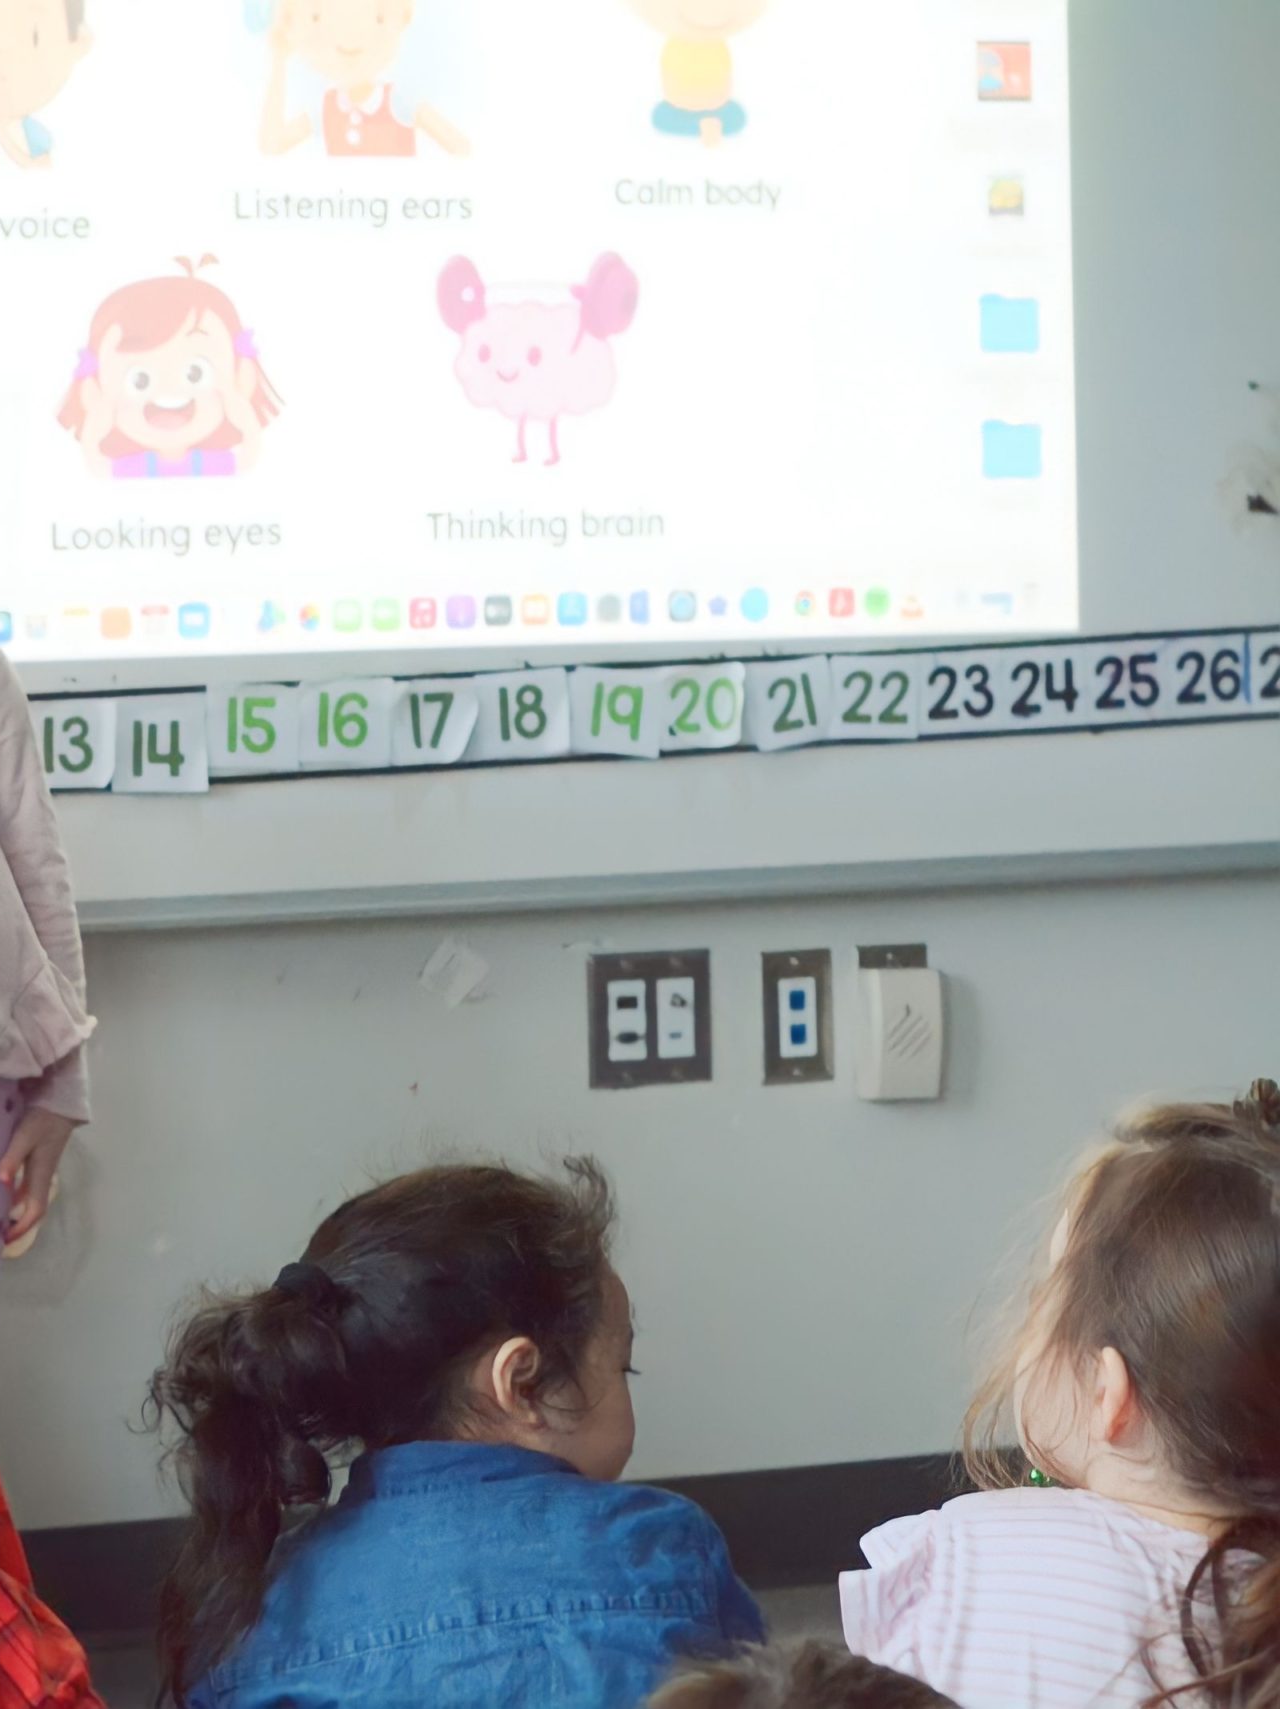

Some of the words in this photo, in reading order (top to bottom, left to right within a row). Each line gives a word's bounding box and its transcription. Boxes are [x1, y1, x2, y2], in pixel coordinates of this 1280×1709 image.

[235, 190, 388, 228] Listening
[402, 198, 472, 219] ears
[614, 178, 694, 206] Calm
[705, 179, 781, 209] body
[0, 209, 90, 239] voice
[52, 520, 191, 557] Looking
[205, 524, 281, 553] eyes
[427, 511, 567, 547] Thinking
[582, 512, 664, 538] brain
[44, 717, 93, 773] 13
[133, 721, 184, 776] 14
[228, 698, 275, 753] 15
[318, 693, 367, 747] 16
[409, 692, 453, 748] 17
[499, 685, 546, 741] 18
[592, 683, 643, 740] 19
[669, 677, 736, 733] 20
[768, 674, 817, 732] 21
[842, 671, 909, 724] 22
[928, 664, 994, 720] 23
[1011, 659, 1078, 717] 24
[1096, 653, 1159, 707] 25
[1176, 651, 1240, 704] 26
[1260, 646, 1280, 698] 2
